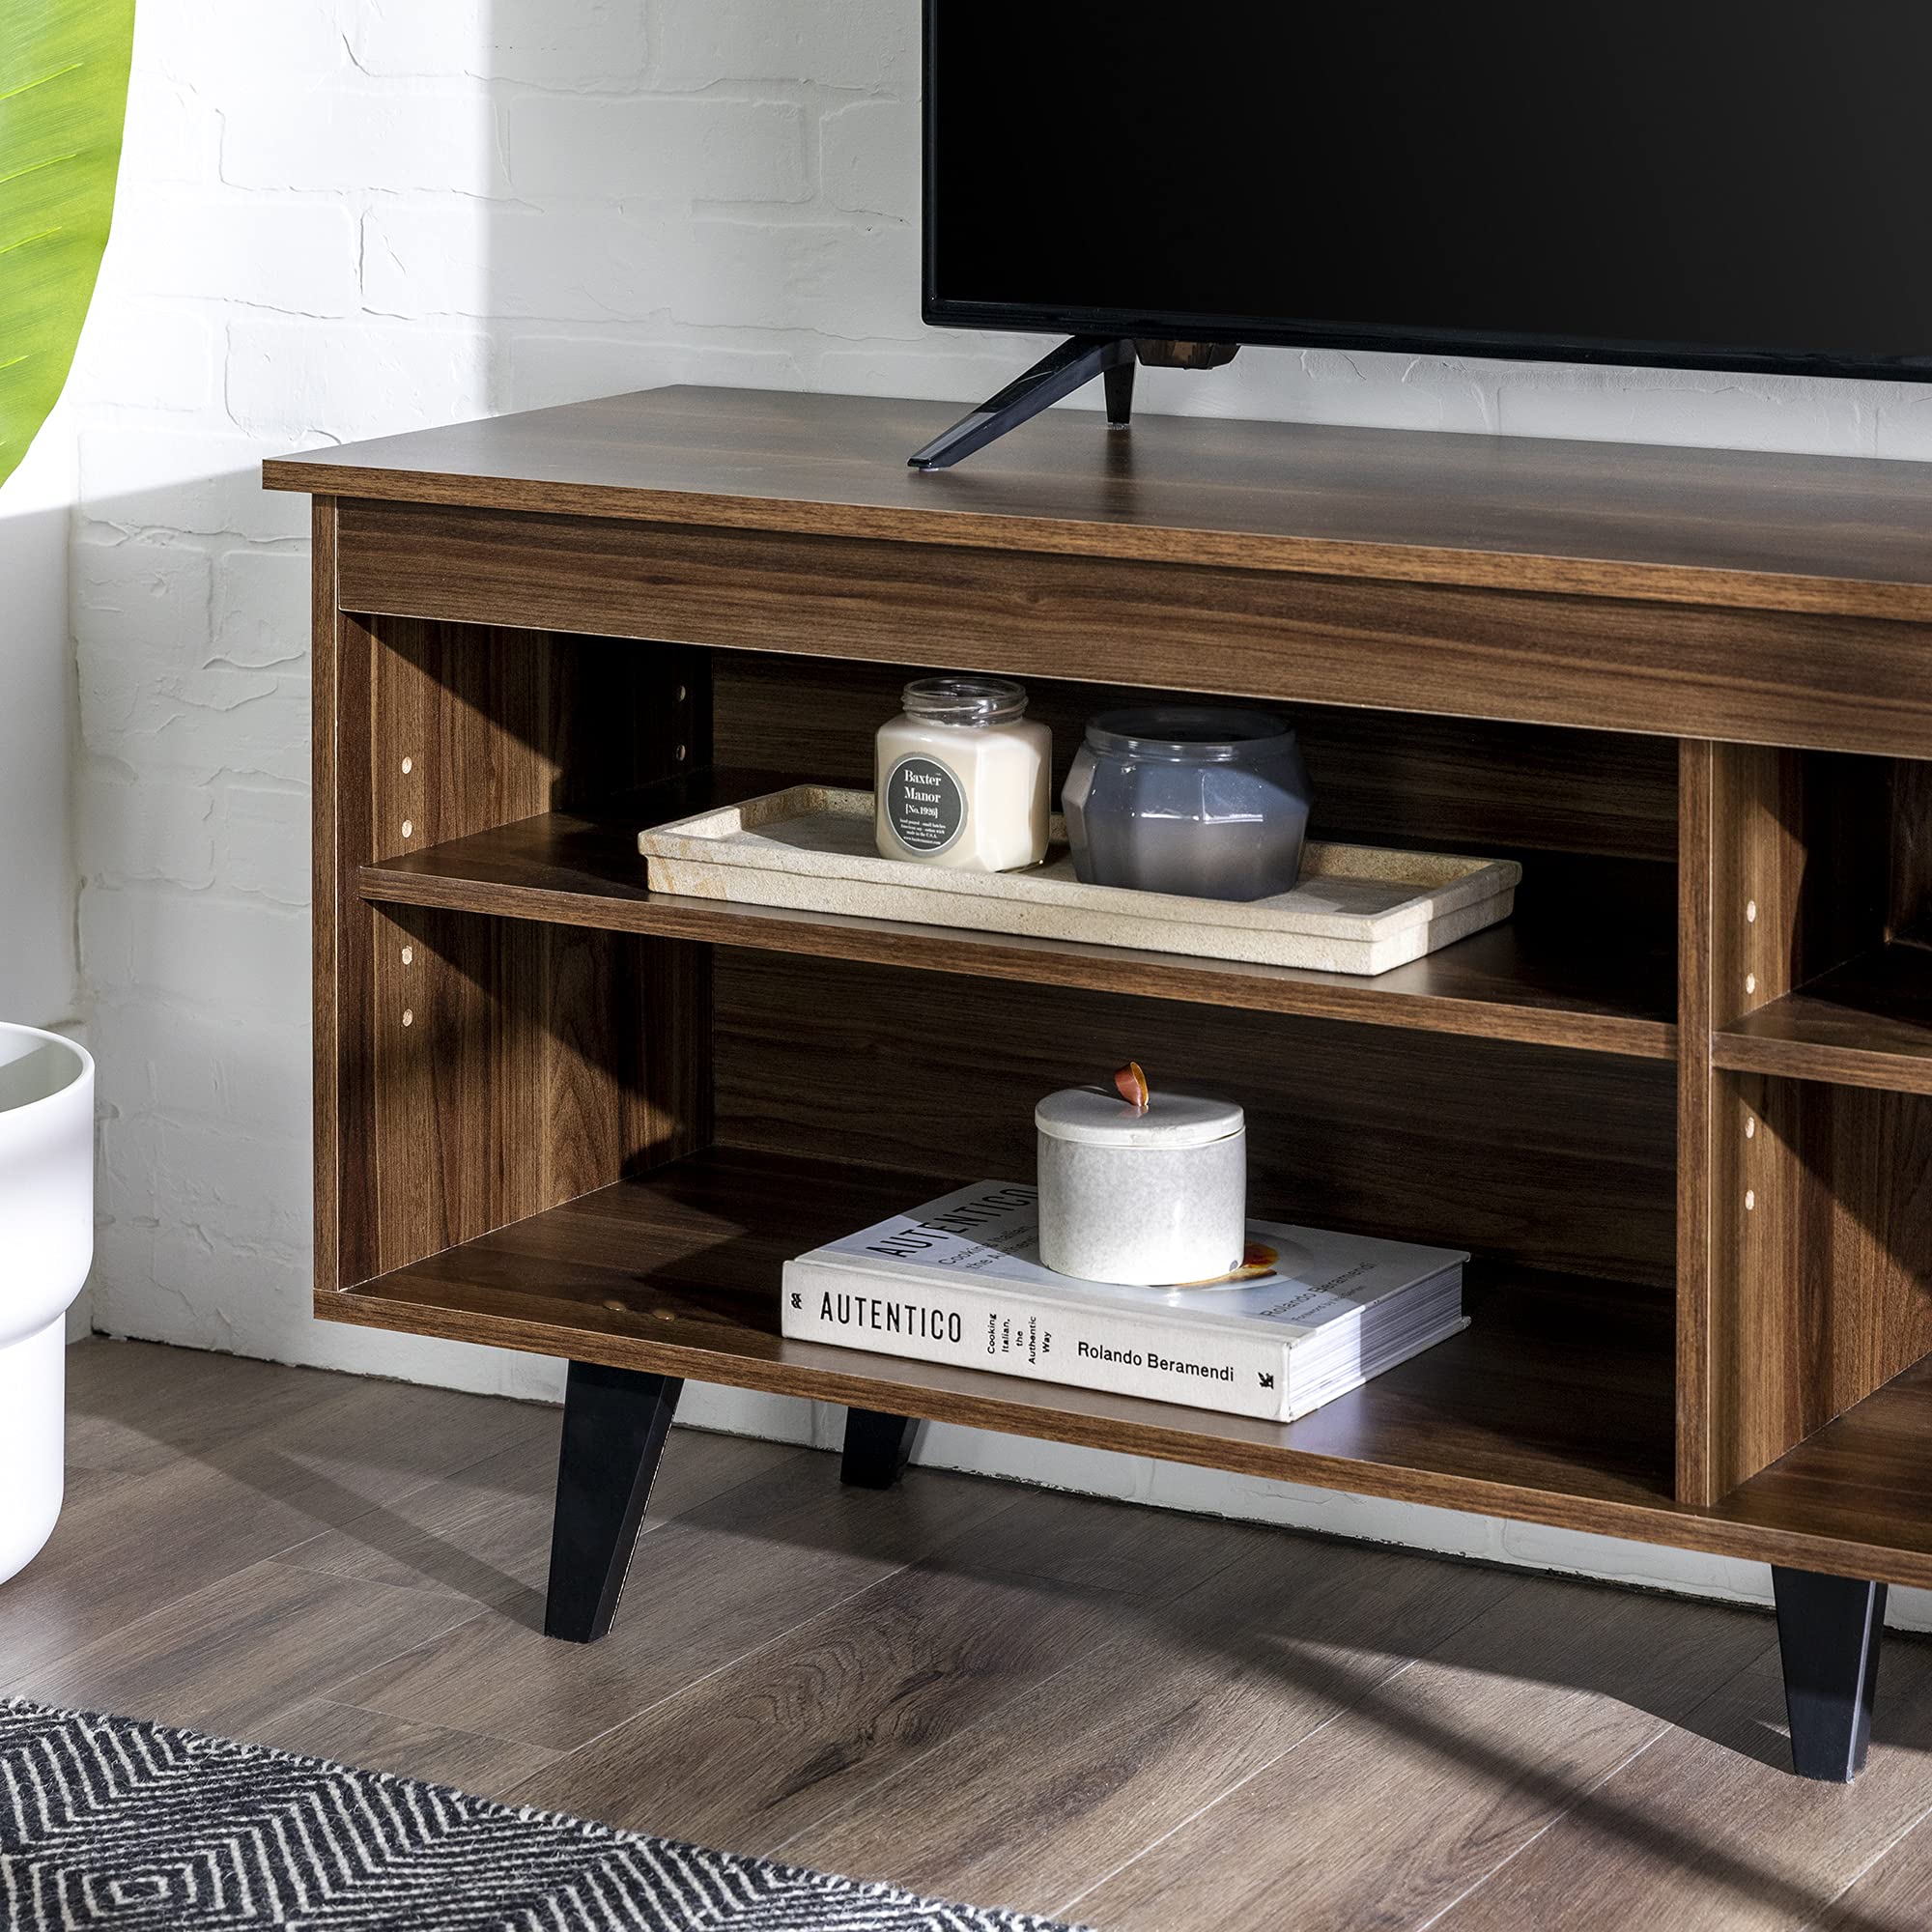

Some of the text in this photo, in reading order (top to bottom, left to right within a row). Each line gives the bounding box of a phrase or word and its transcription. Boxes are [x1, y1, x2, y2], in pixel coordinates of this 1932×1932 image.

[904, 769, 942, 786] Baxter
[904, 786, 942, 803] Manor
[866, 1188, 1037, 1258] AUTENTICO
[938, 1242, 999, 1265] Cooking
[966, 1259, 994, 1269] the
[1260, 1292, 1317, 1318] Rolando
[1308, 1262, 1378, 1293] Beramendi
[820, 1291, 961, 1344] AUTENTICO
[987, 1313, 997, 1354] Cooking
[1001, 1319, 1010, 1353] Italian,
[1015, 1330, 1024, 1347] the
[1028, 1316, 1037, 1365] Authentic
[1042, 1331, 1052, 1353] Way
[1077, 1341, 1235, 1382] Rolando Beramendi
